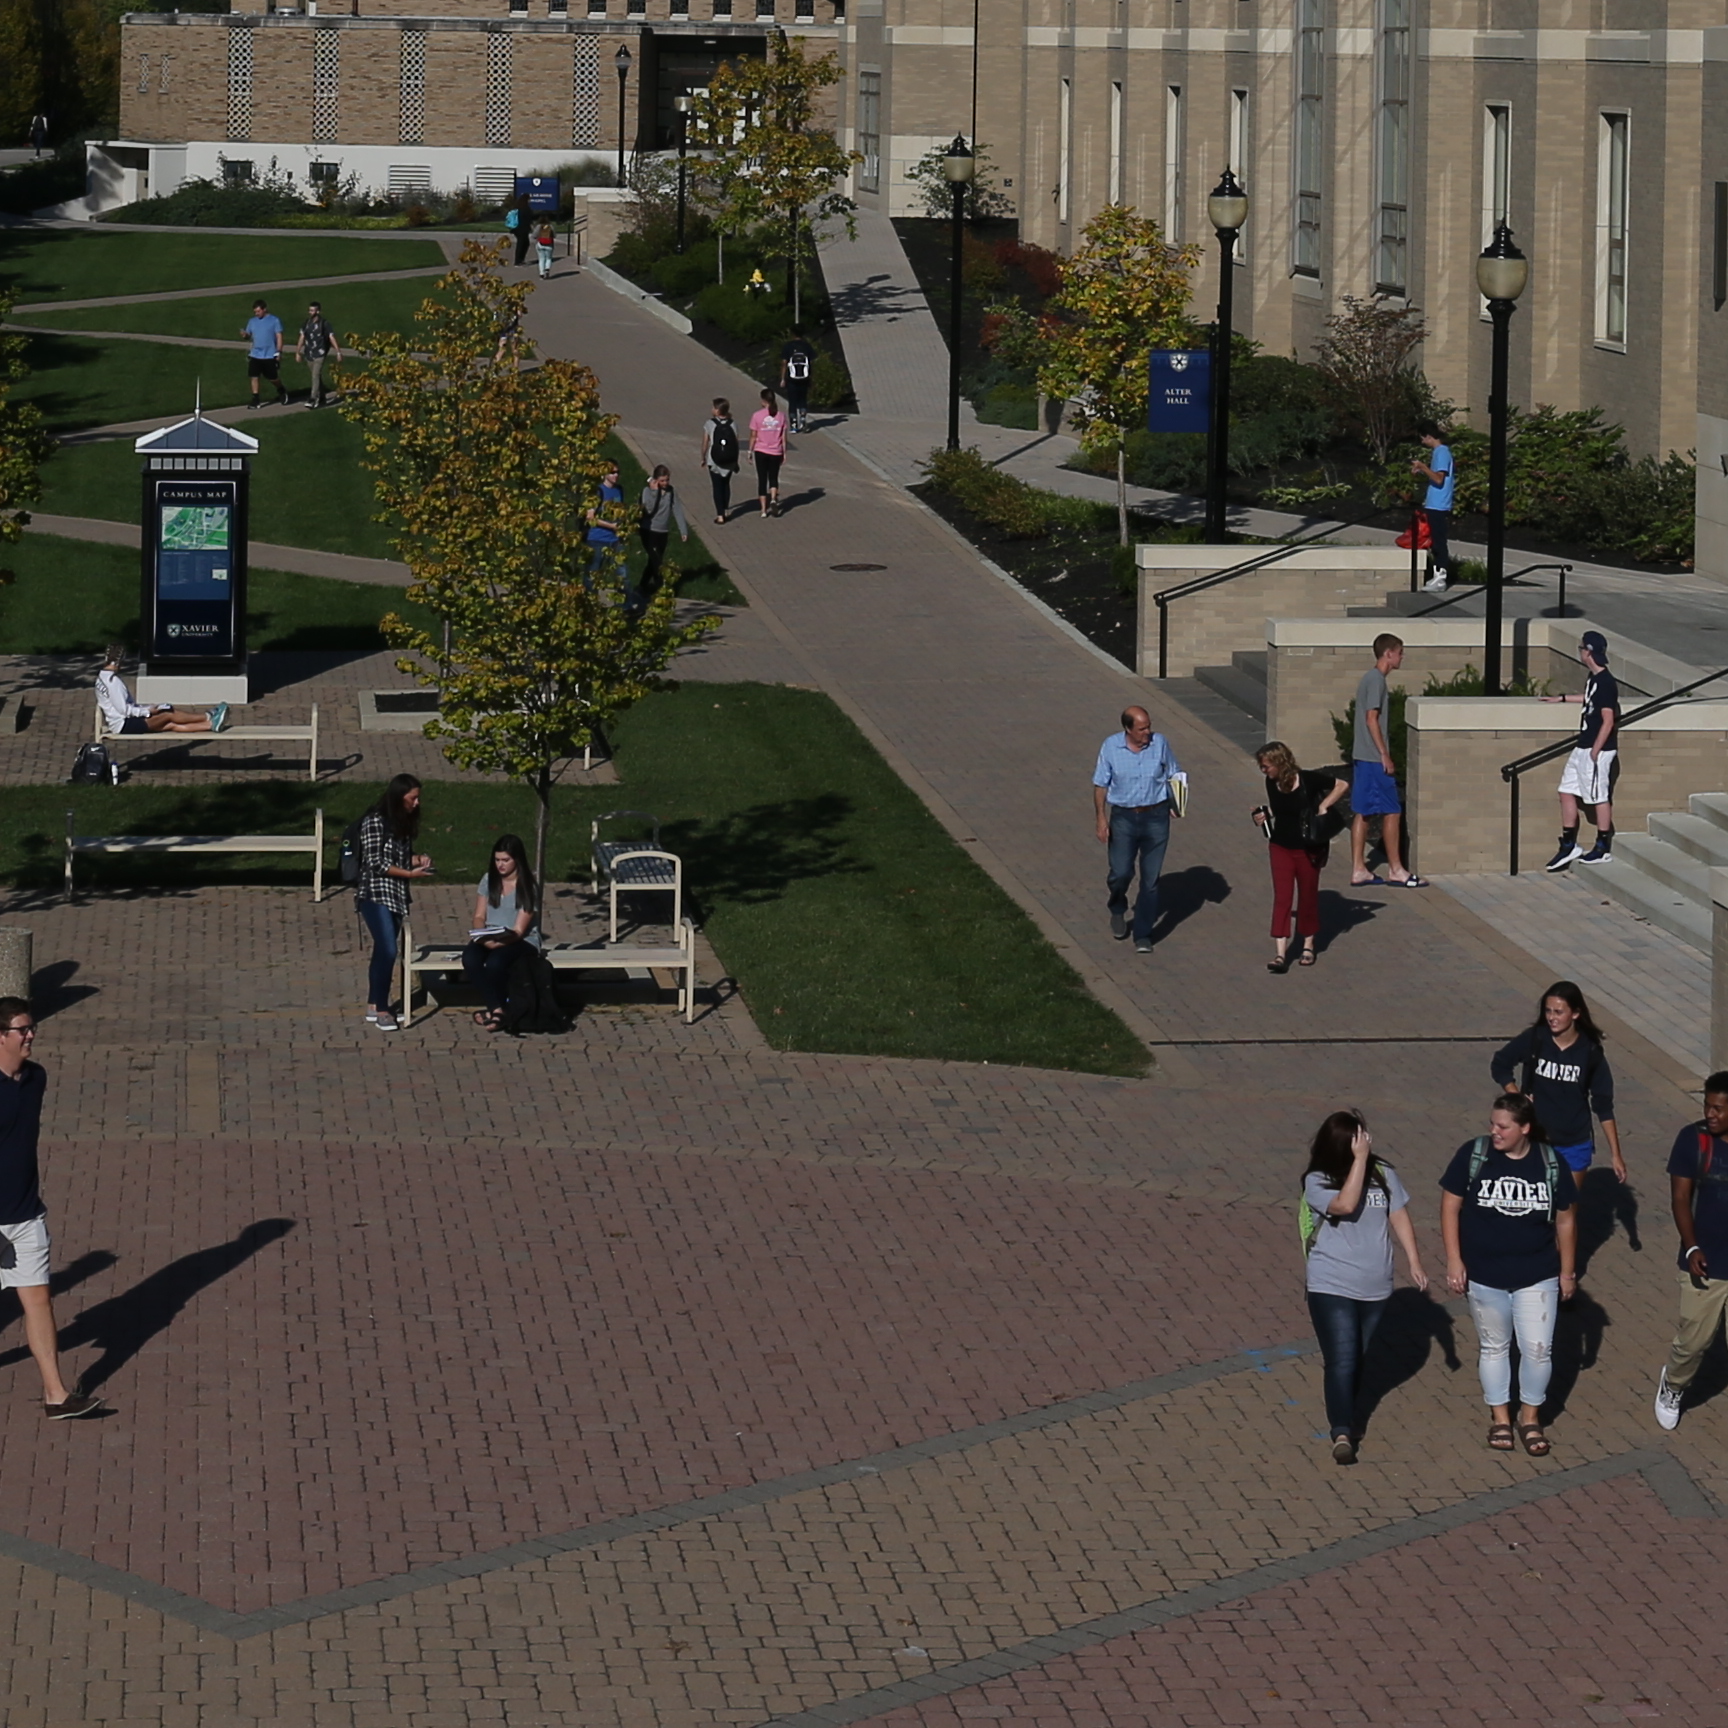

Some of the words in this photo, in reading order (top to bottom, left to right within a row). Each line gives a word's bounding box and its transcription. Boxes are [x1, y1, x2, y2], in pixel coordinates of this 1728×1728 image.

[1164, 388, 1192, 396] ALTER
[1166, 397, 1190, 405] HALL
[181, 624, 219, 633] XAVIER
[1534, 1058, 1581, 1083] XAVIER
[1476, 1179, 1550, 1202] XAVIER
